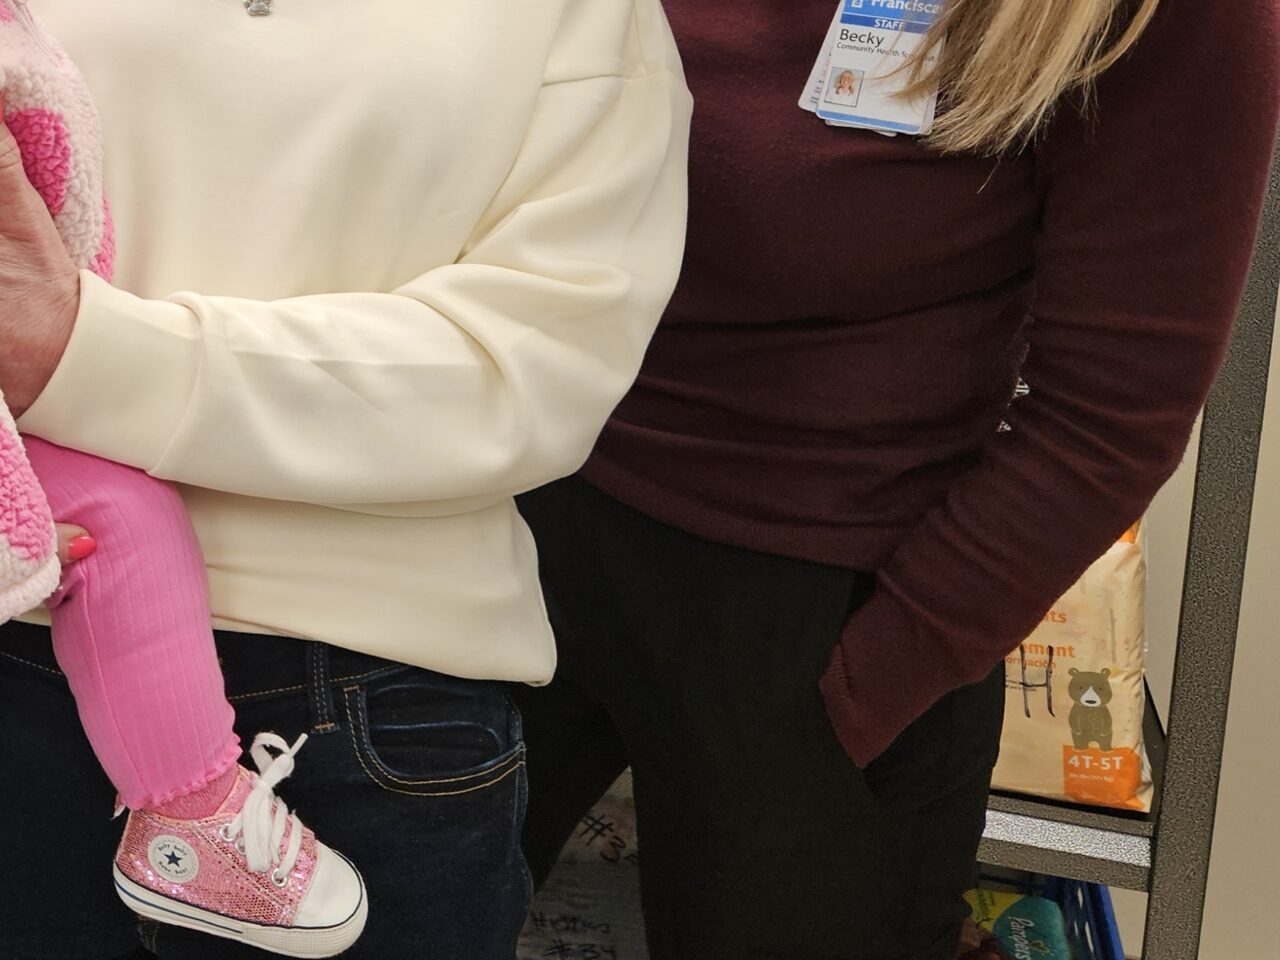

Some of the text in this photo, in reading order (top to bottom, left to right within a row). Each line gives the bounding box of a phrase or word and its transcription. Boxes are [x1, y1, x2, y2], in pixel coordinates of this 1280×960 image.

[874, 19, 906, 30] STAFF
[840, 29, 885, 48] Becky
[837, 42, 875, 54] Community
[1068, 755, 1123, 770] 4T-5T
[1008, 916, 1035, 960] Pampers
